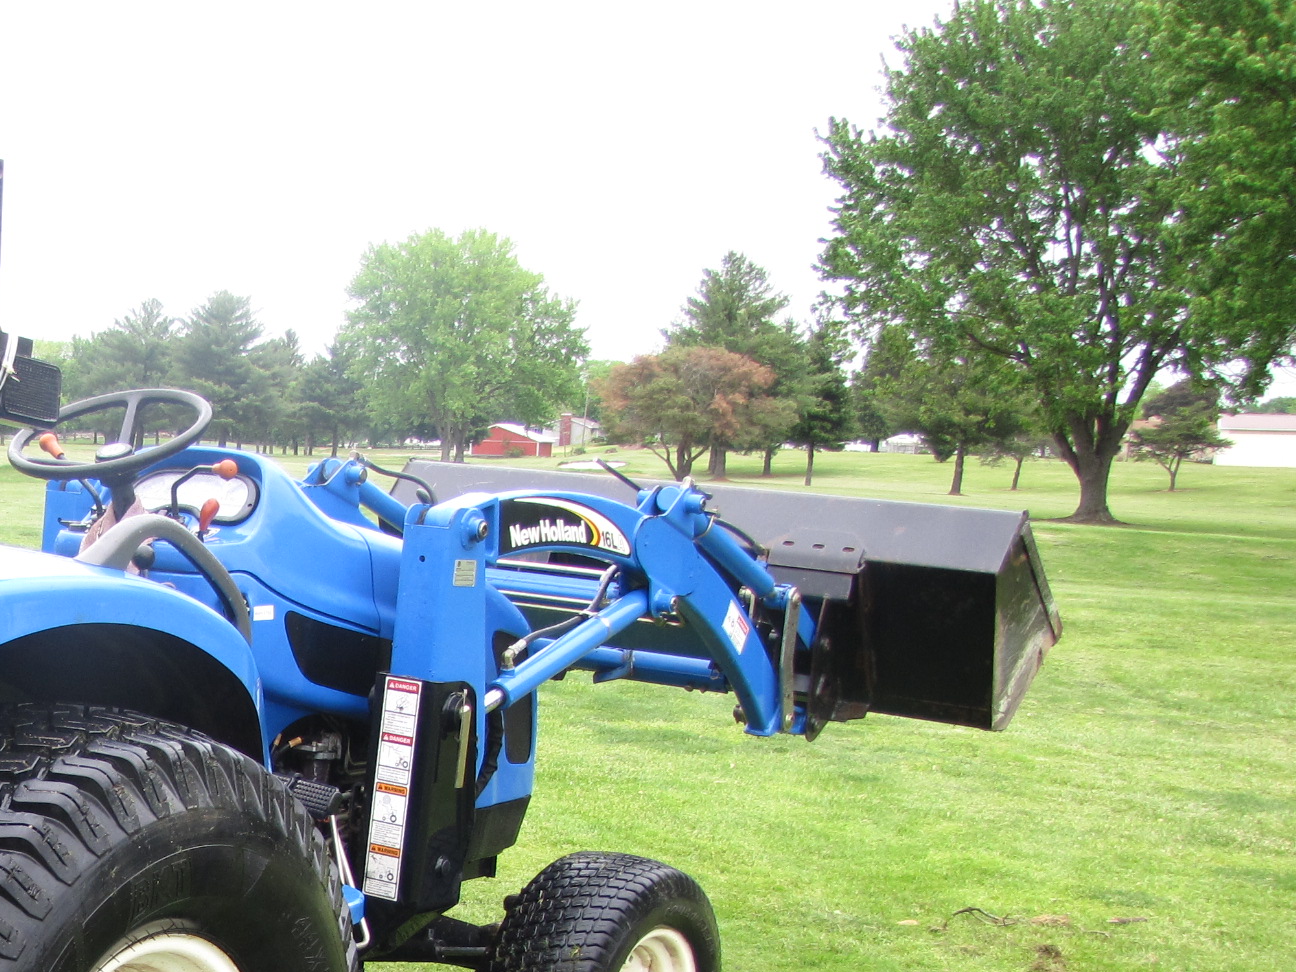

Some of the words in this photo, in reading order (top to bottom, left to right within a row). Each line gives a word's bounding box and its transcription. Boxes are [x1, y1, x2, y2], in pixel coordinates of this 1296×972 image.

[509, 523, 540, 548] New
[539, 519, 587, 544] Holland
[394, 682, 417, 692] DANGER
[388, 735, 411, 744] DANGER
[384, 785, 405, 794] WARNING
